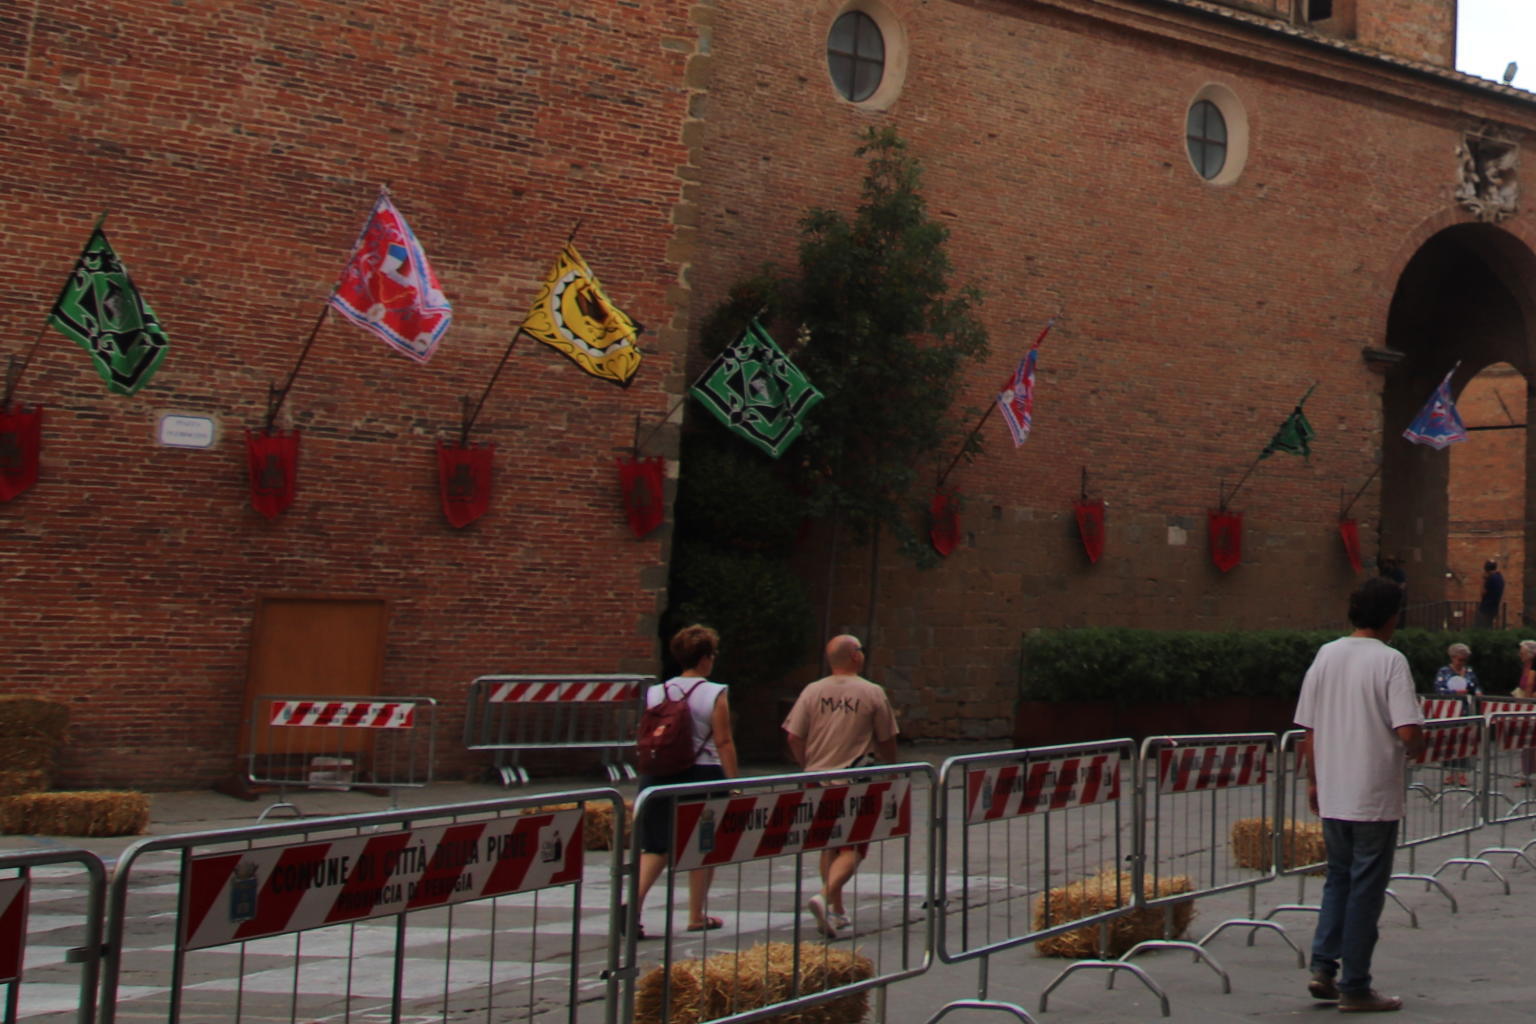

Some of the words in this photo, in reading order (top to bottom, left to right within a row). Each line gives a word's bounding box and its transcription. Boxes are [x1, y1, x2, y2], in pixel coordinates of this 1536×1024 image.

[270, 853, 350, 895] COMUNE
[357, 856, 377, 880] DI
[382, 838, 428, 877] CITTÀ
[433, 839, 479, 872] DELLA
